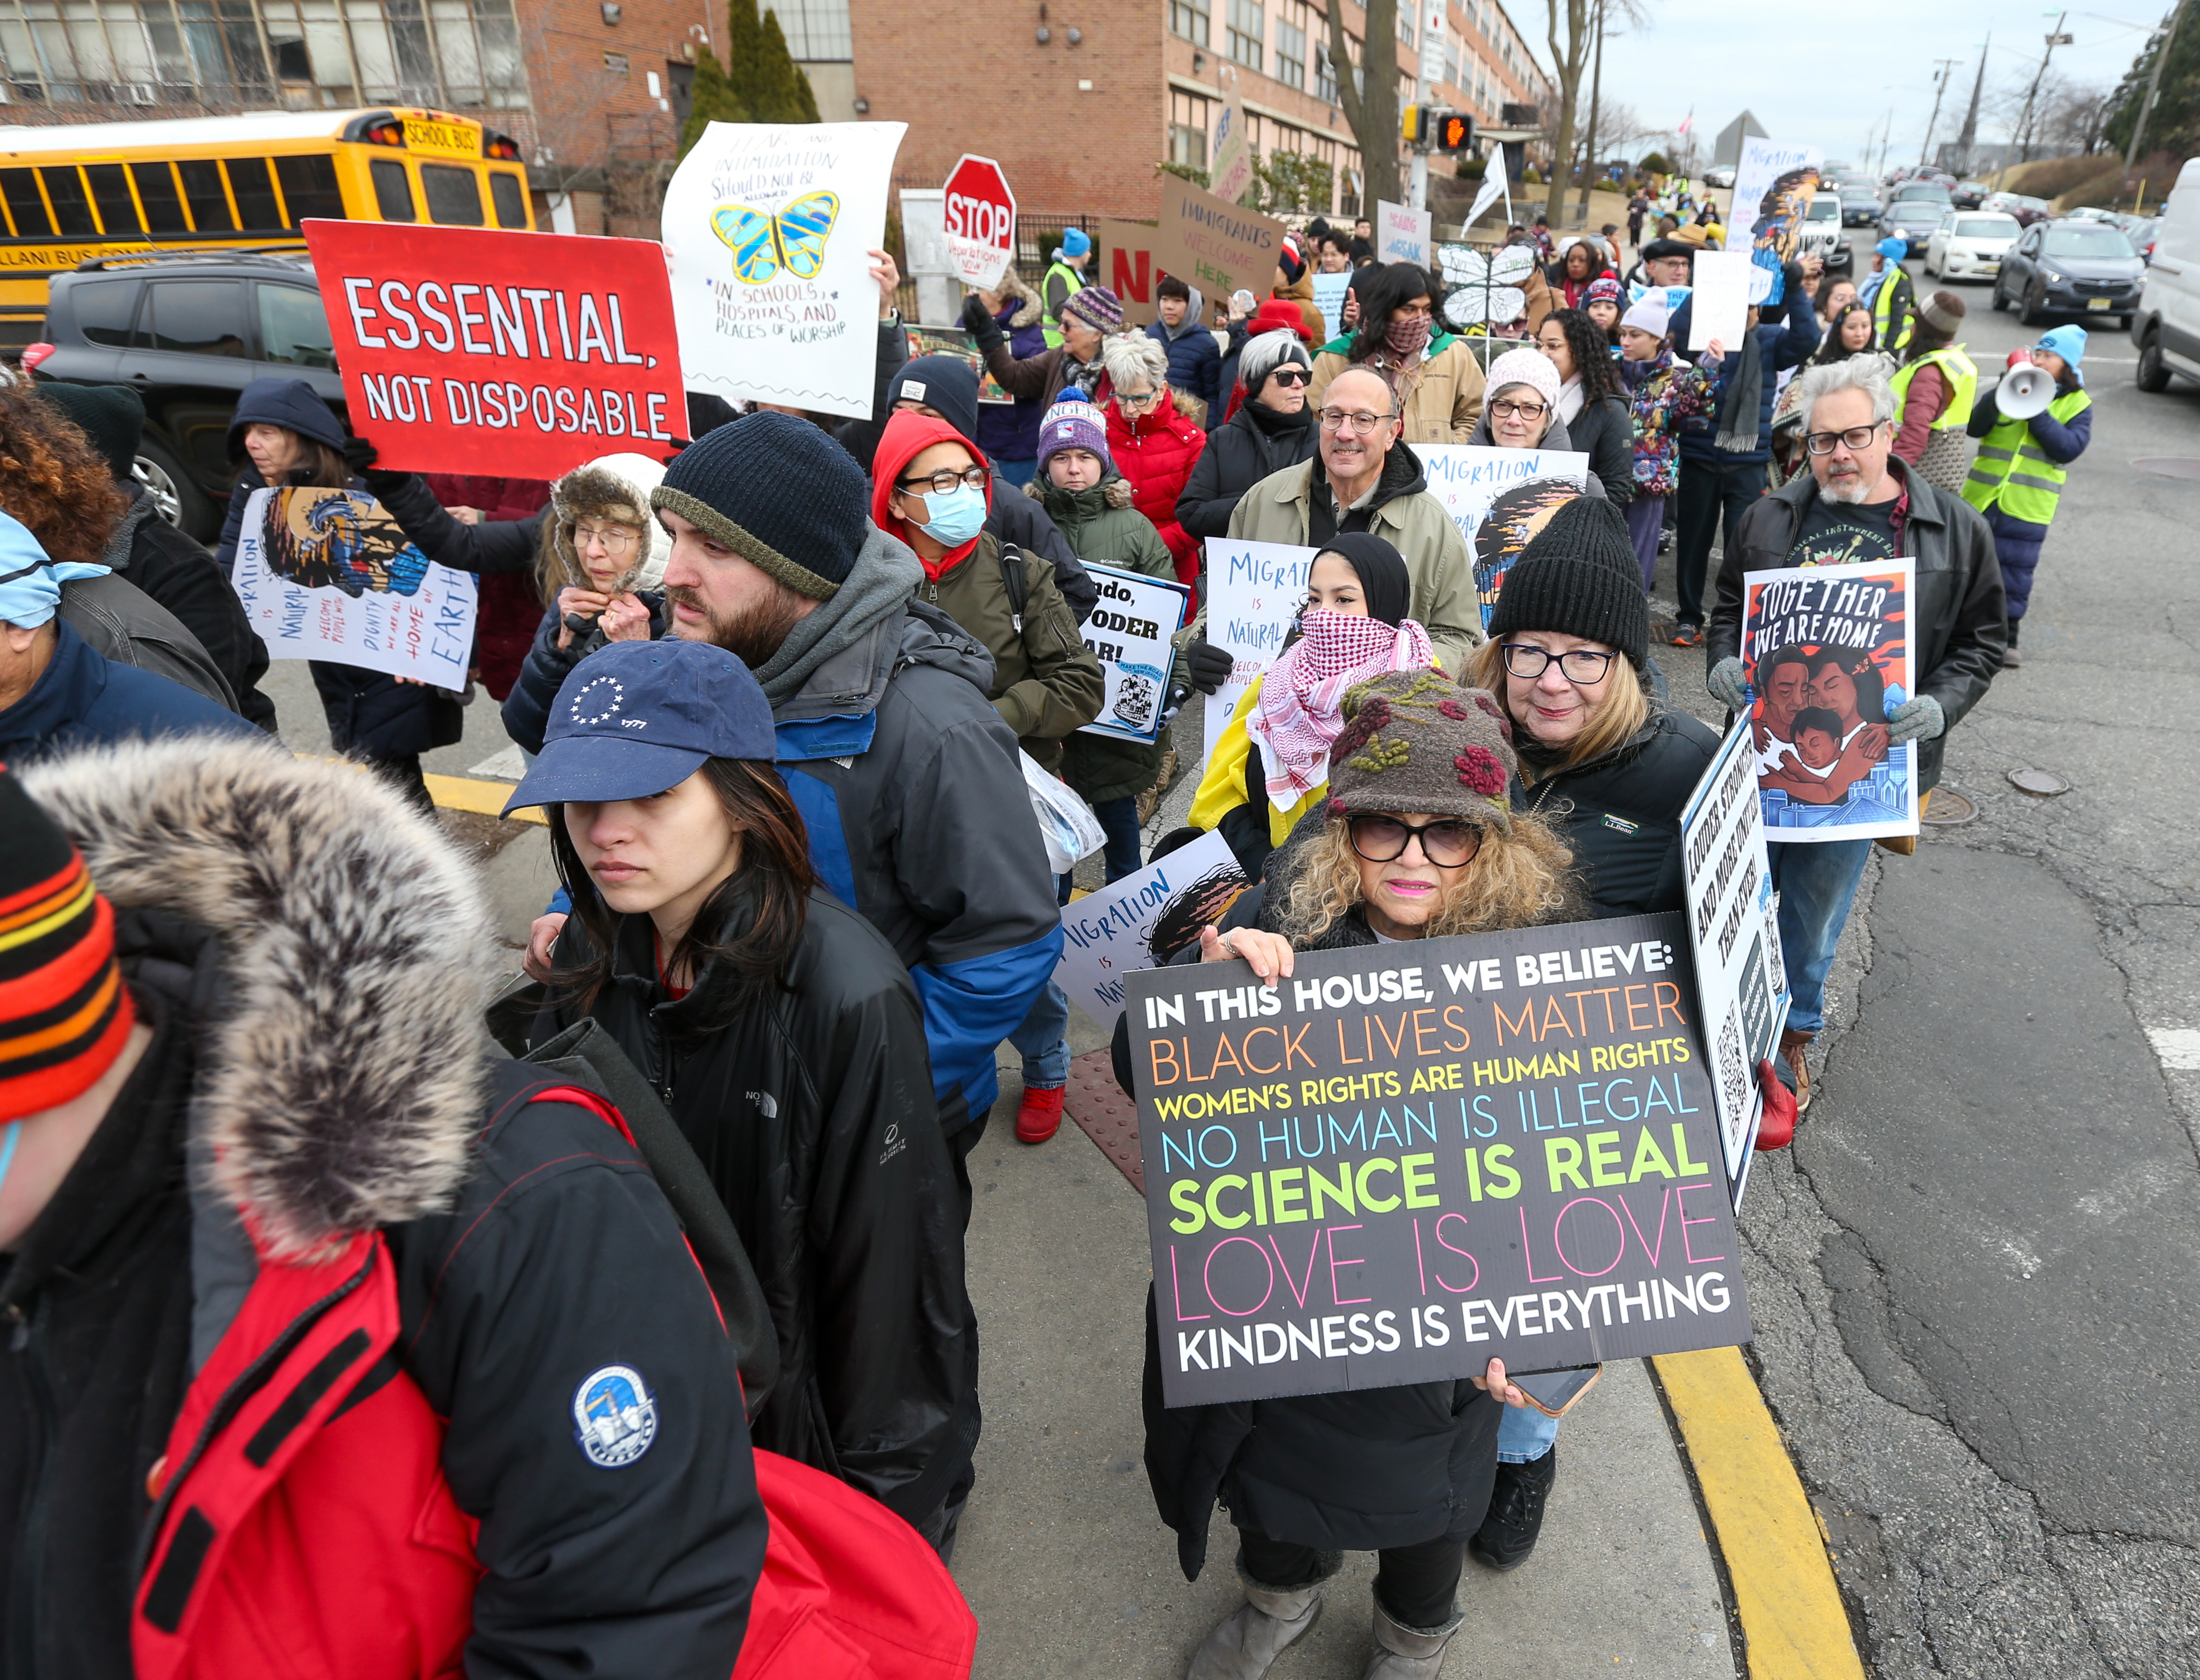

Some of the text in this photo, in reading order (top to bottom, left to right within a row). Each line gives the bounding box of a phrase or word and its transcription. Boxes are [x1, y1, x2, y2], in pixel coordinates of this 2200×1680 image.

[408, 123, 474, 150] SCHOOL BUS
[711, 174, 766, 201] SHOULD
[800, 170, 817, 185] BE
[744, 189, 788, 203] ALLOWED
[947, 191, 1010, 249] STOP
[1182, 197, 1271, 248] IMMIGRANTS
[55, 249, 94, 265] BUS
[1183, 227, 1254, 271] WELCOME
[715, 280, 826, 303] IN SCHOOLS,
[1113, 247, 1168, 303] N
[1195, 258, 1234, 293] HERE
[343, 277, 658, 370] ESSENTIAL,
[716, 299, 836, 324] HOSPITALS, AND
[716, 317, 846, 343] PLACES OF WORSHIP
[362, 372, 672, 442] NOT DISPOSABLE
[1426, 454, 1540, 486] MIGRATION
[1447, 494, 1457, 505] IS
[1826, 524, 1885, 544] INSTRUMENT
[1228, 552, 1310, 590] MIGRAT
[422, 587, 433, 604] ON
[1093, 580, 1136, 607] ndo,
[1252, 597, 1262, 610] IS
[1760, 574, 1887, 627] TOGETHER
[262, 608, 274, 618] IS
[278, 586, 310, 640] NATURAL
[318, 597, 332, 640] WELCOME
[331, 595, 346, 645] PEOPLE WITH
[363, 598, 386, 652] DIGNITY
[386, 600, 401, 650] WE ARE ALL
[430, 568, 469, 667] EARTH
[1091, 609, 1159, 641] ODER
[405, 604, 424, 660] HOME
[1226, 617, 1284, 651] NATURAL
[1753, 613, 1884, 662] WE ARE HOME
[1084, 638, 1124, 664] AR!
[1231, 660, 1262, 672] WELCO
[1144, 670, 1161, 682] JERSEY
[1148, 666, 1163, 678] ROAD
[1225, 673, 1254, 686] PEOPLE
[621, 718, 648, 730] 1777
[1605, 820, 1632, 834] L.L.Bean
[1687, 737, 1754, 888] LOUDER, STRONGER
[1697, 786, 1759, 948] AND MORE UNITED
[1718, 852, 1758, 971] THAN EVER!
[1098, 955, 1112, 969] IS
[1145, 940, 1674, 1029] IN THIS HOUSE, WE BELIEVE:
[1150, 981, 1687, 1087] BLACK LIVES MATTER
[1301, 1070, 1399, 1104] RIGHTS
[1409, 1061, 1464, 1093] ARE
[1473, 1048, 1582, 1087] HUMAN
[1591, 1036, 1691, 1073] RIGHTS
[1162, 1071, 1700, 1174] NO HUMAN IS ILLEGAL
[880, 1138, 906, 1160] FLIGHT
[880, 1144, 907, 1166] SERIES
[1168, 1121, 1710, 1235] SCIENCE IS REAL
[1170, 1182, 1726, 1322] LOVE IS LOVE
[1178, 1271, 1732, 1373] KINDNESS IS EVERYTHING
